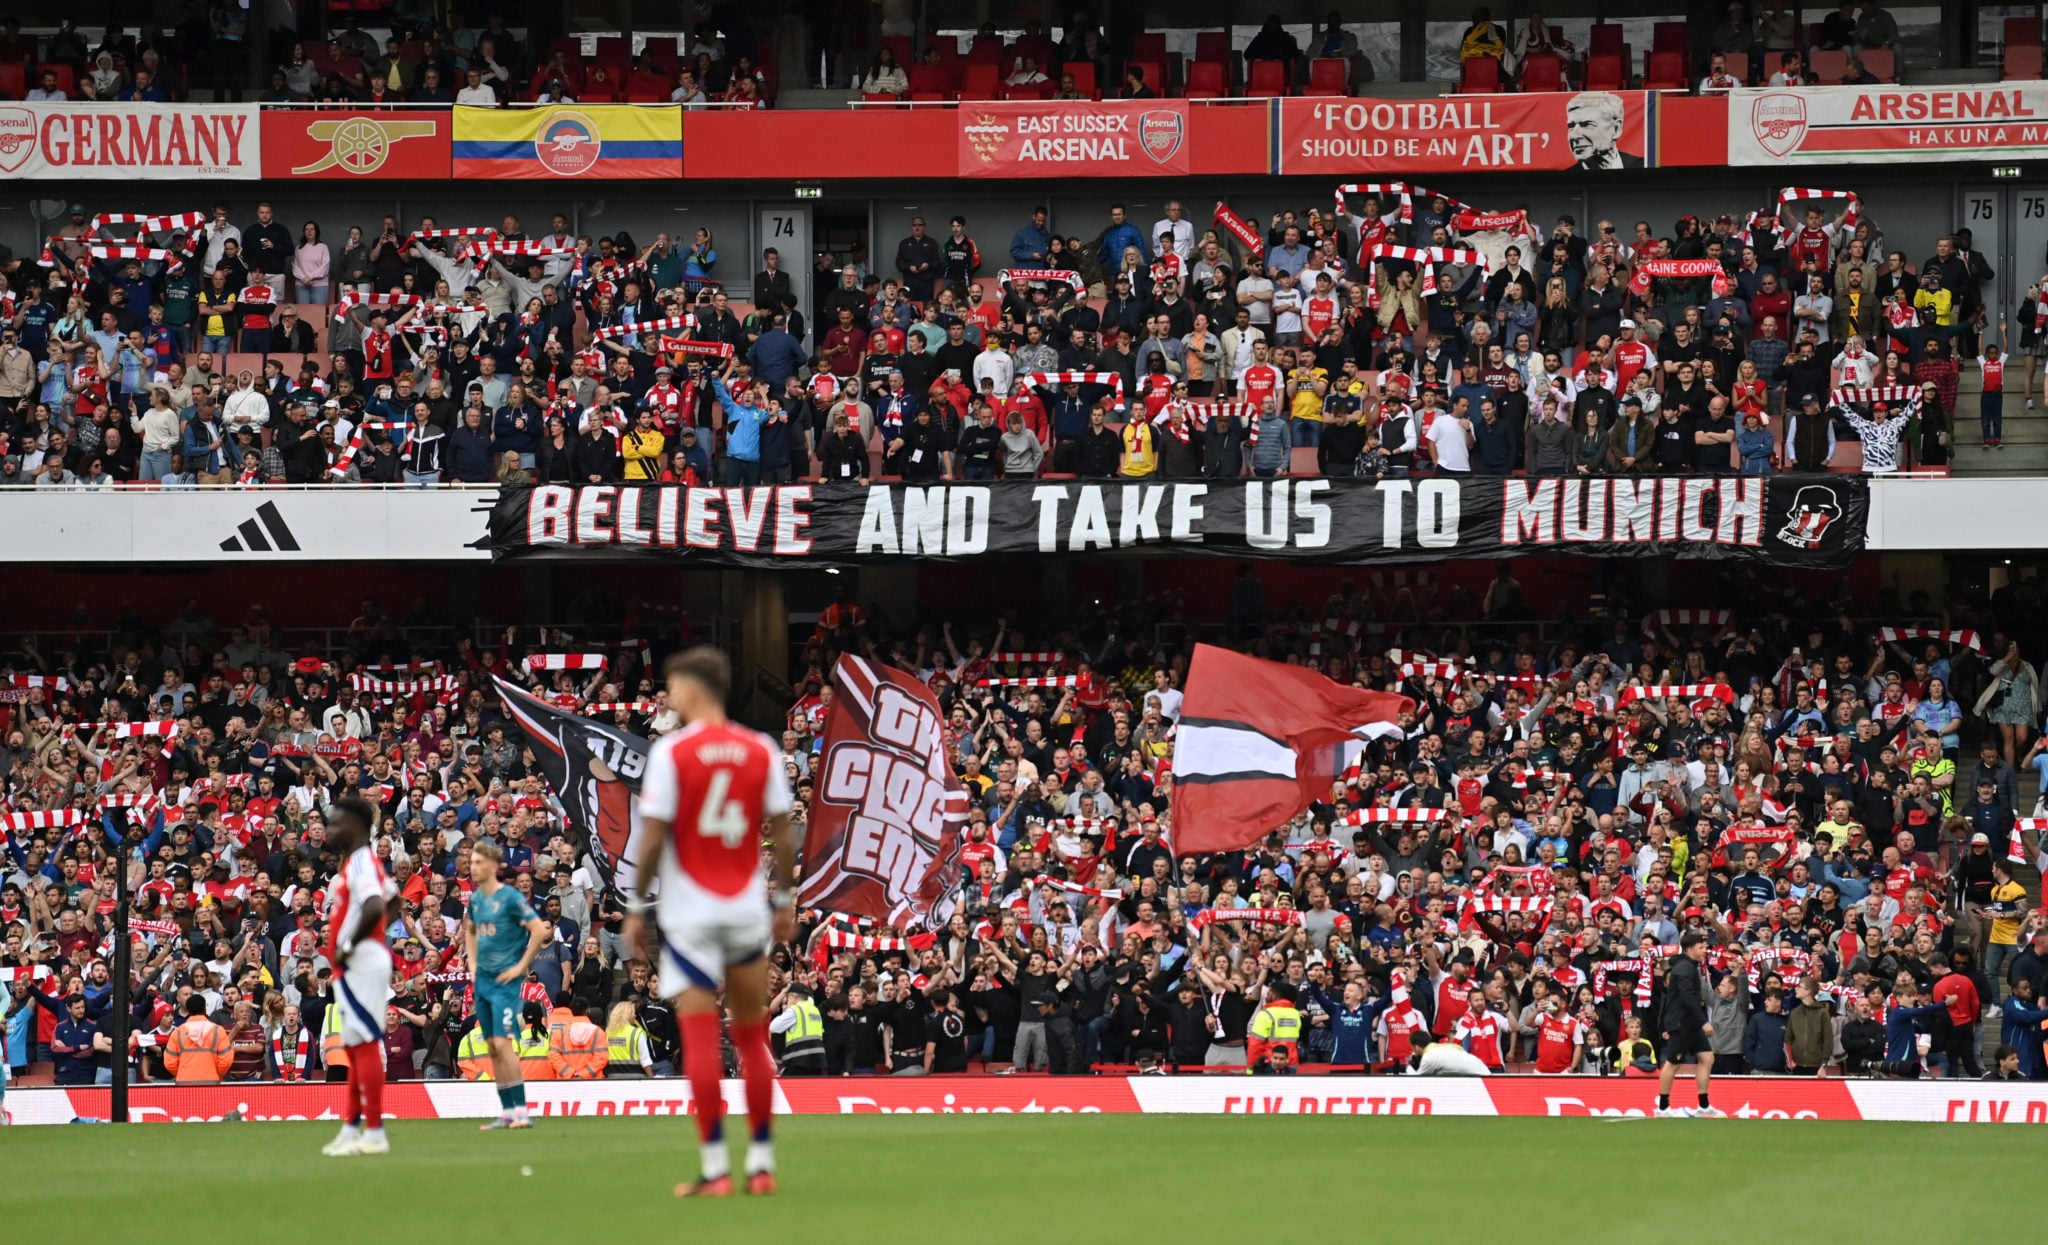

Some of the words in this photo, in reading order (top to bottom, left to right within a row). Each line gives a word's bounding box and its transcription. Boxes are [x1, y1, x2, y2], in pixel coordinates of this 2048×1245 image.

[1760, 104, 1800, 116] Arsenal
[1850, 90, 2034, 121] ARSENAL
[1017, 116, 1060, 133] EAST
[1063, 114, 1129, 133] SUSSEX
[1145, 119, 1177, 128] Arsenal
[40, 112, 248, 167] GERMANY
[1908, 128, 2008, 145] HAKUNA
[1017, 137, 1130, 161] ARSENAL
[1301, 138, 1389, 158] SHOULD
[1394, 138, 1420, 157] BE
[1426, 137, 1457, 156] AN
[1971, 199, 1993, 220] 75
[2023, 198, 2045, 219] 75
[773, 217, 794, 238] 74
[1220, 211, 1259, 247] Arsenal
[667, 341, 718, 355] Gunners
[527, 483, 814, 555] BELIEVE
[856, 485, 992, 556] AND
[1031, 483, 1208, 553] TAKE
[1242, 478, 1330, 549] US
[1374, 478, 1462, 549] TO
[1500, 478, 1764, 547] MUNICH
[697, 768, 750, 848] 4
[1735, 828, 1788, 840] Arsenal
[1214, 909, 1261, 921] ARSENAL
[1264, 910, 1282, 921] F.C.
[502, 1007, 513, 1026] 2
